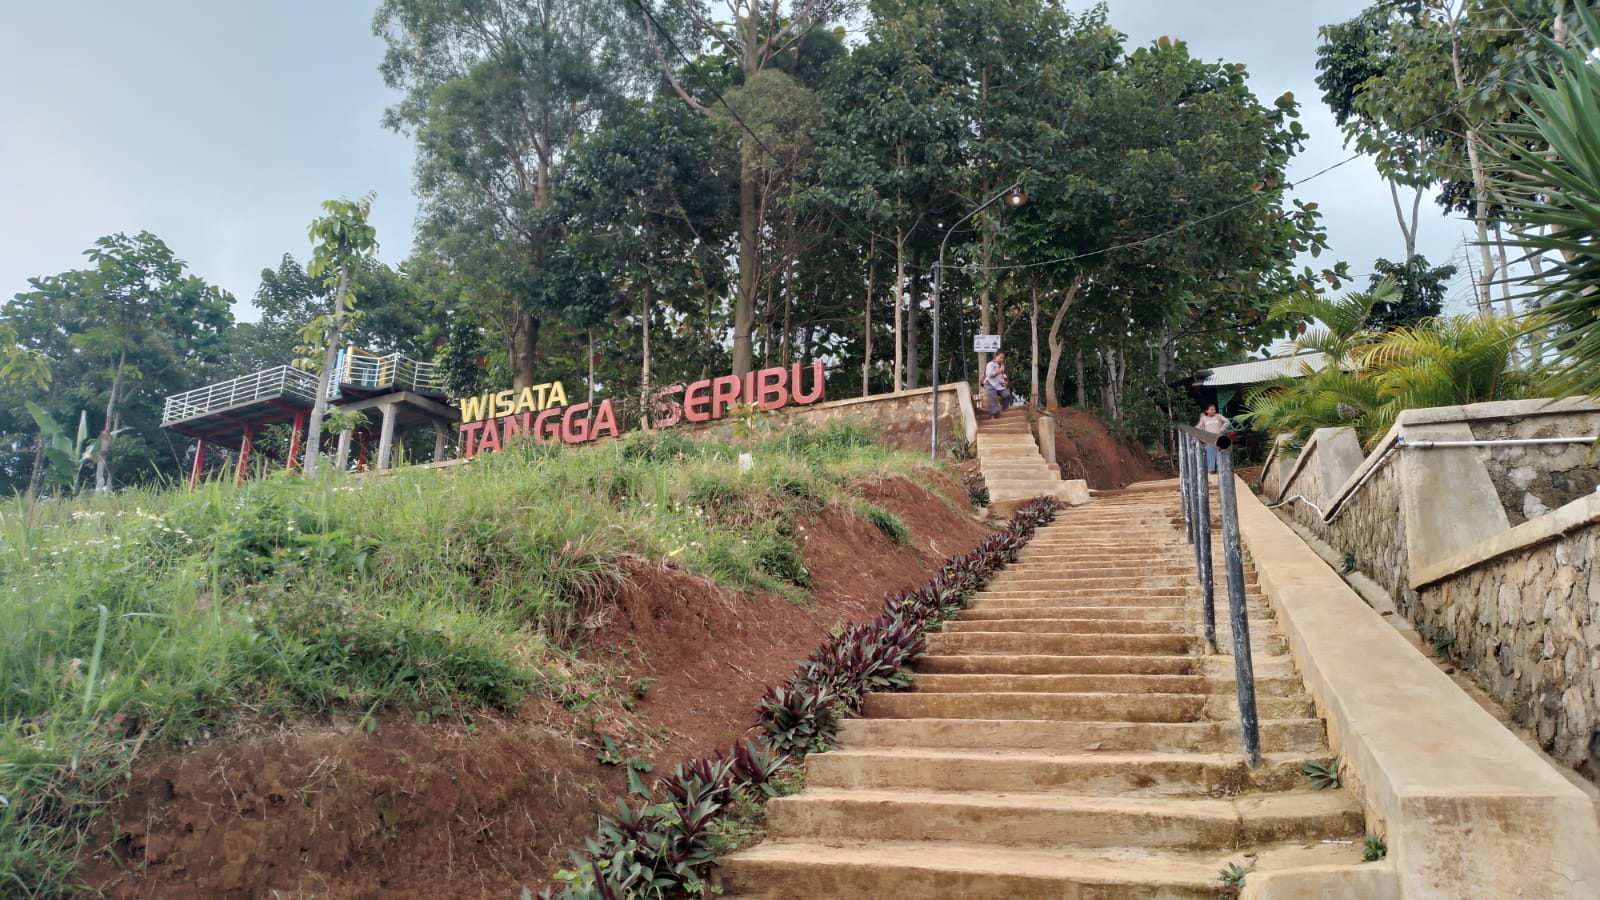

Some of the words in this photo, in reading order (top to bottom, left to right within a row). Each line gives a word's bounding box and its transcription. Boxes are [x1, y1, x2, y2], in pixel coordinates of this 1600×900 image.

[460, 381, 568, 423] WISATA
[460, 400, 620, 457] TANGGA
[651, 359, 824, 428] SERIBU
